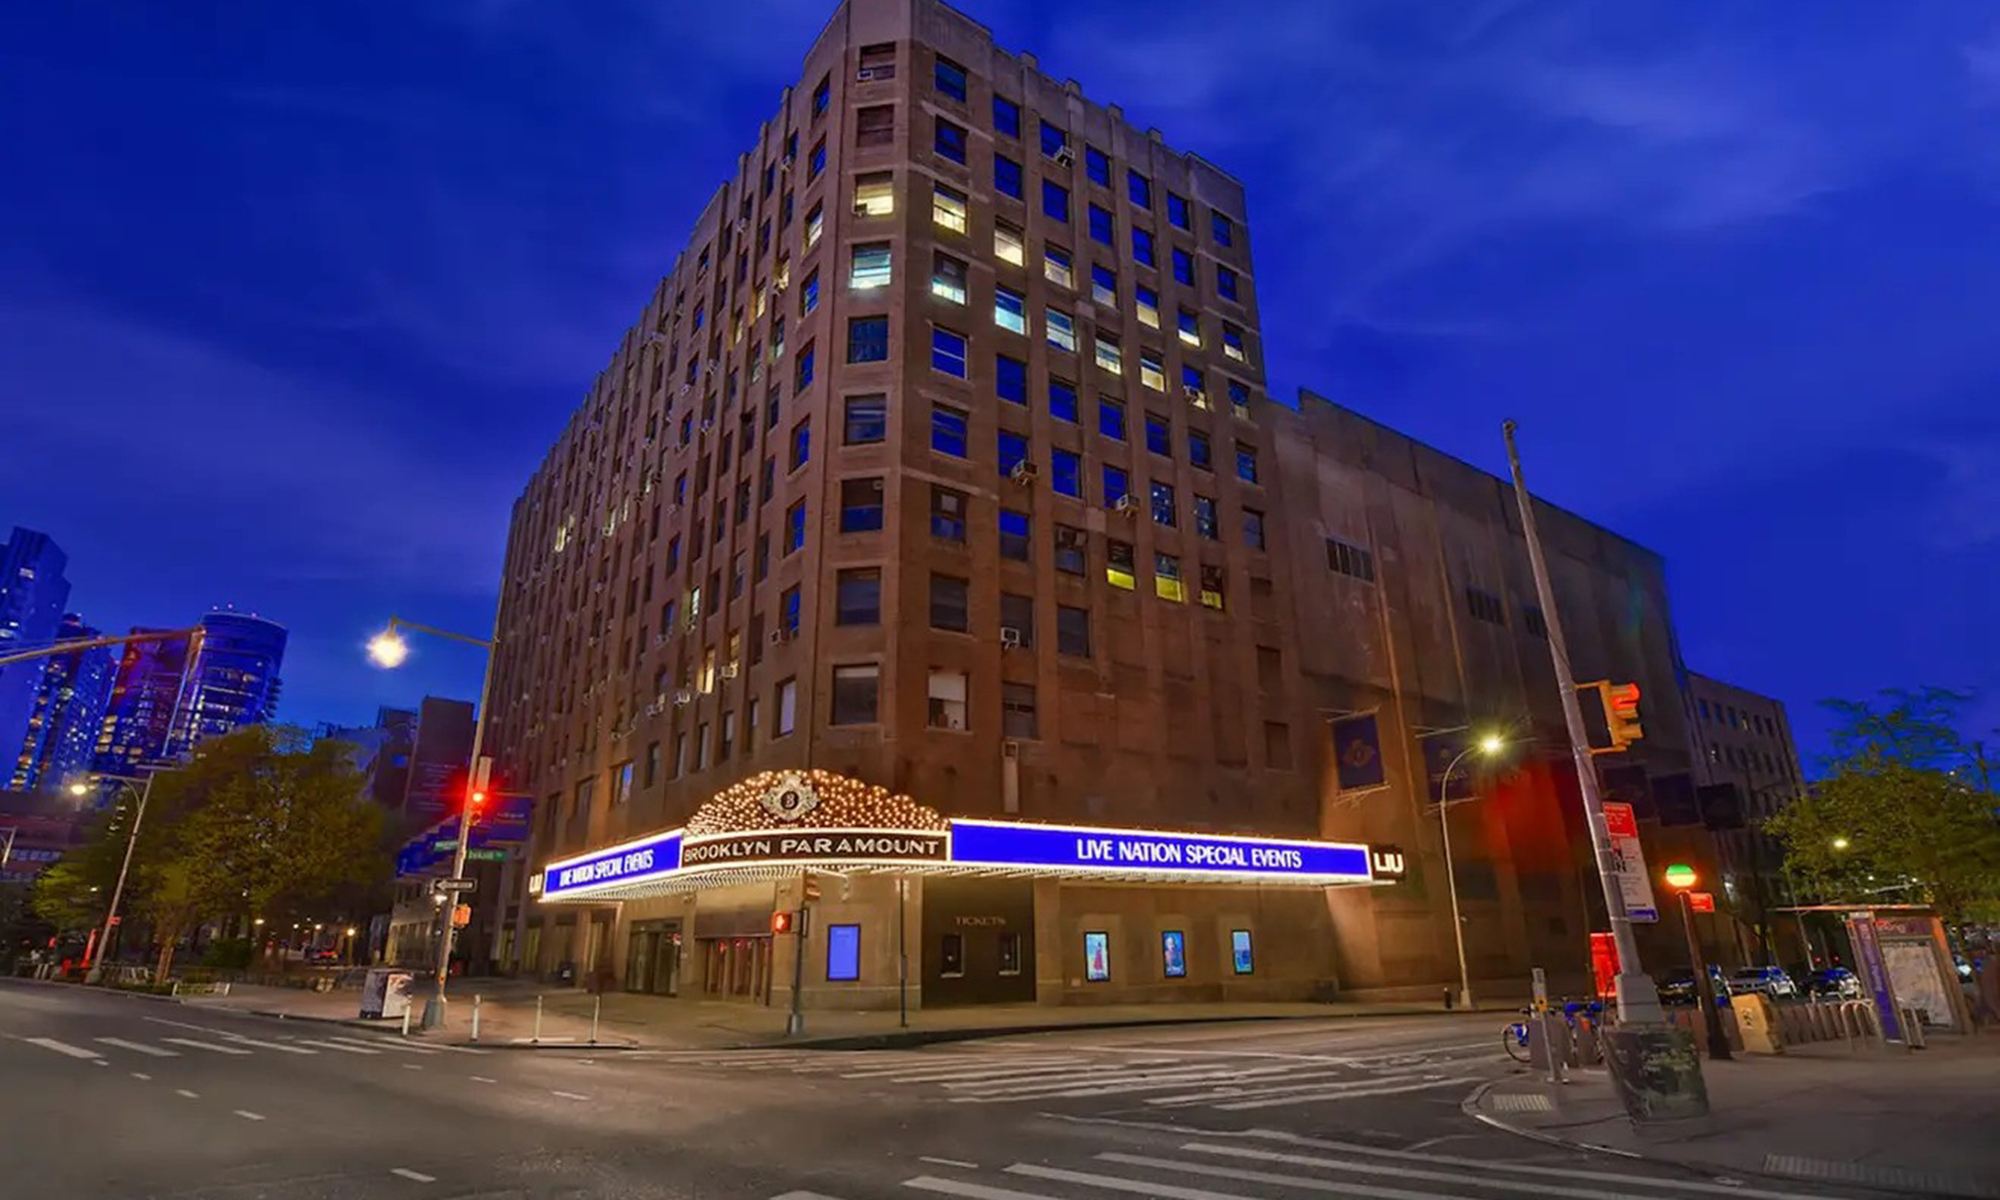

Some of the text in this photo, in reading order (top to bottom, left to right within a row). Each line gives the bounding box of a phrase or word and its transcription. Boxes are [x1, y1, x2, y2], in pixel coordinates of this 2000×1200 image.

[684, 838, 939, 862] BROOKLYN PARAMOUNT
[1077, 839, 1302, 868] LIVE NATION SPECIAL EVENTS
[1373, 852, 1404, 873] LIU
